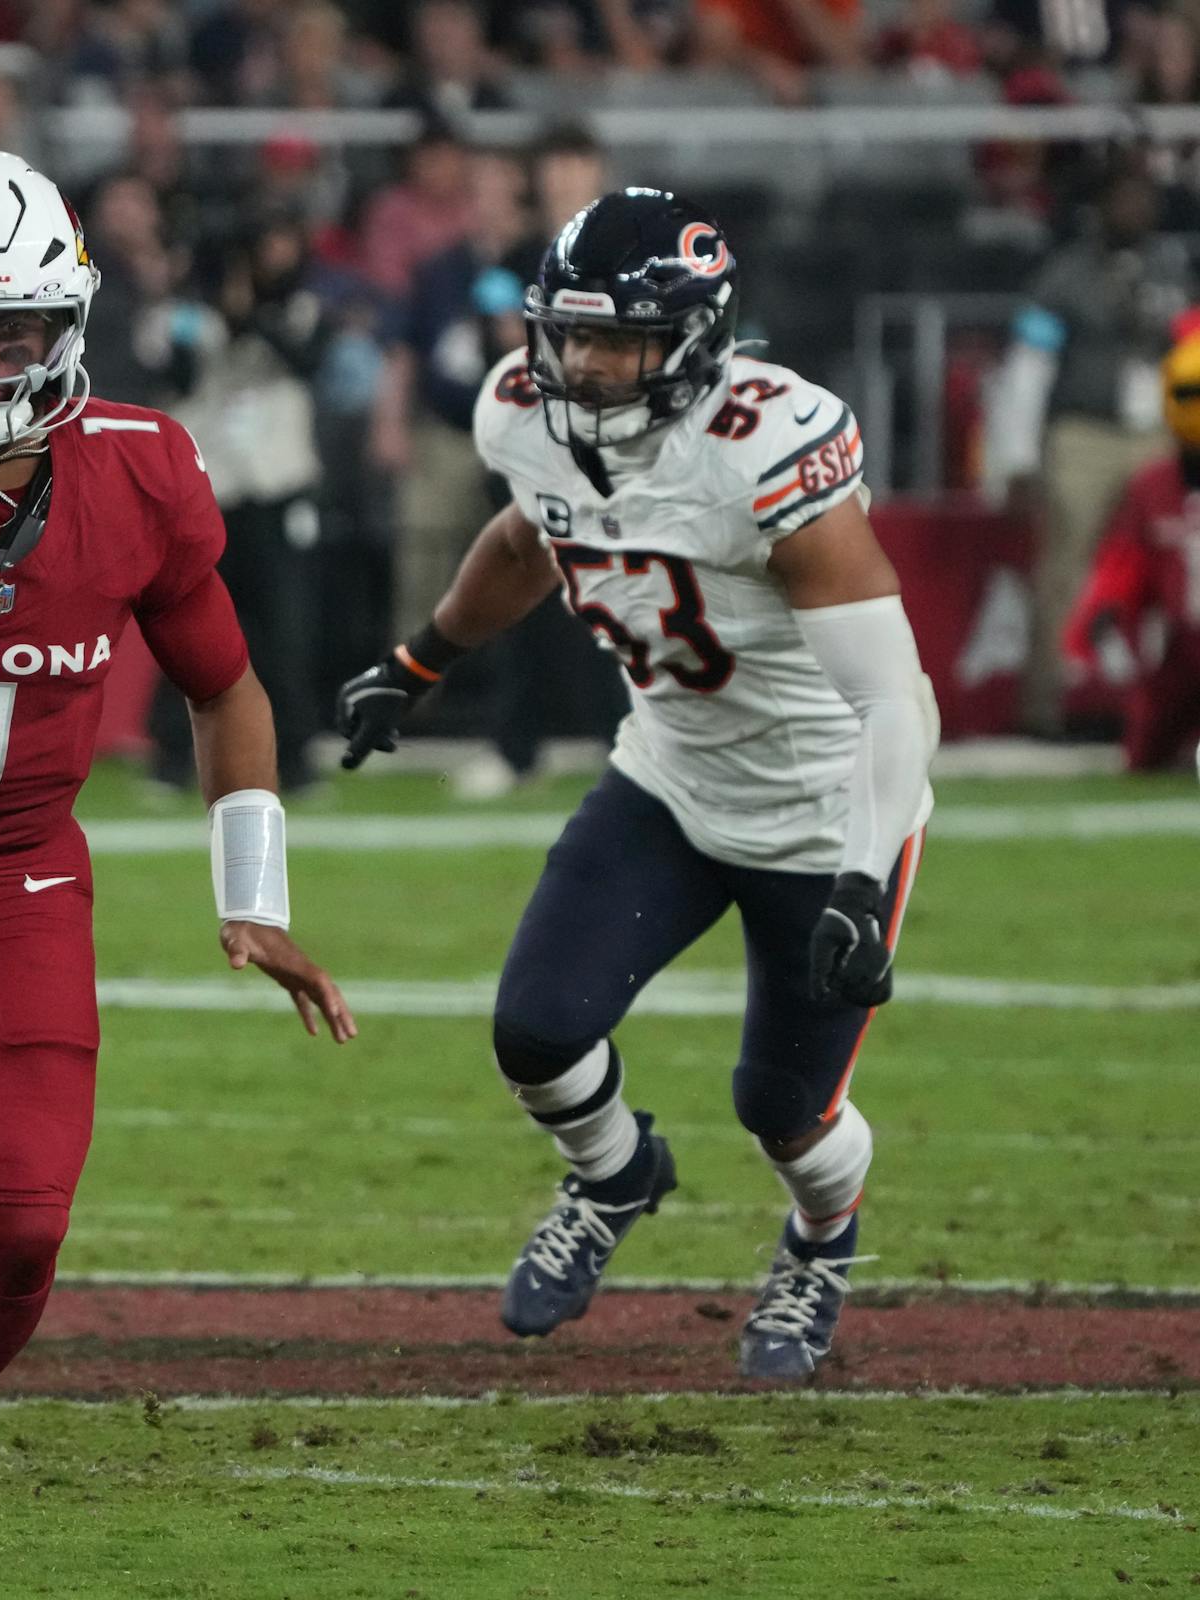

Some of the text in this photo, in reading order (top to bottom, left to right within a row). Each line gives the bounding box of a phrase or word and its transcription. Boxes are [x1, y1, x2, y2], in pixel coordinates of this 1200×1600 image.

[676, 221, 729, 279] C
[81, 416, 161, 435] 1
[797, 430, 856, 497] GSH
[549, 540, 737, 692] 53
